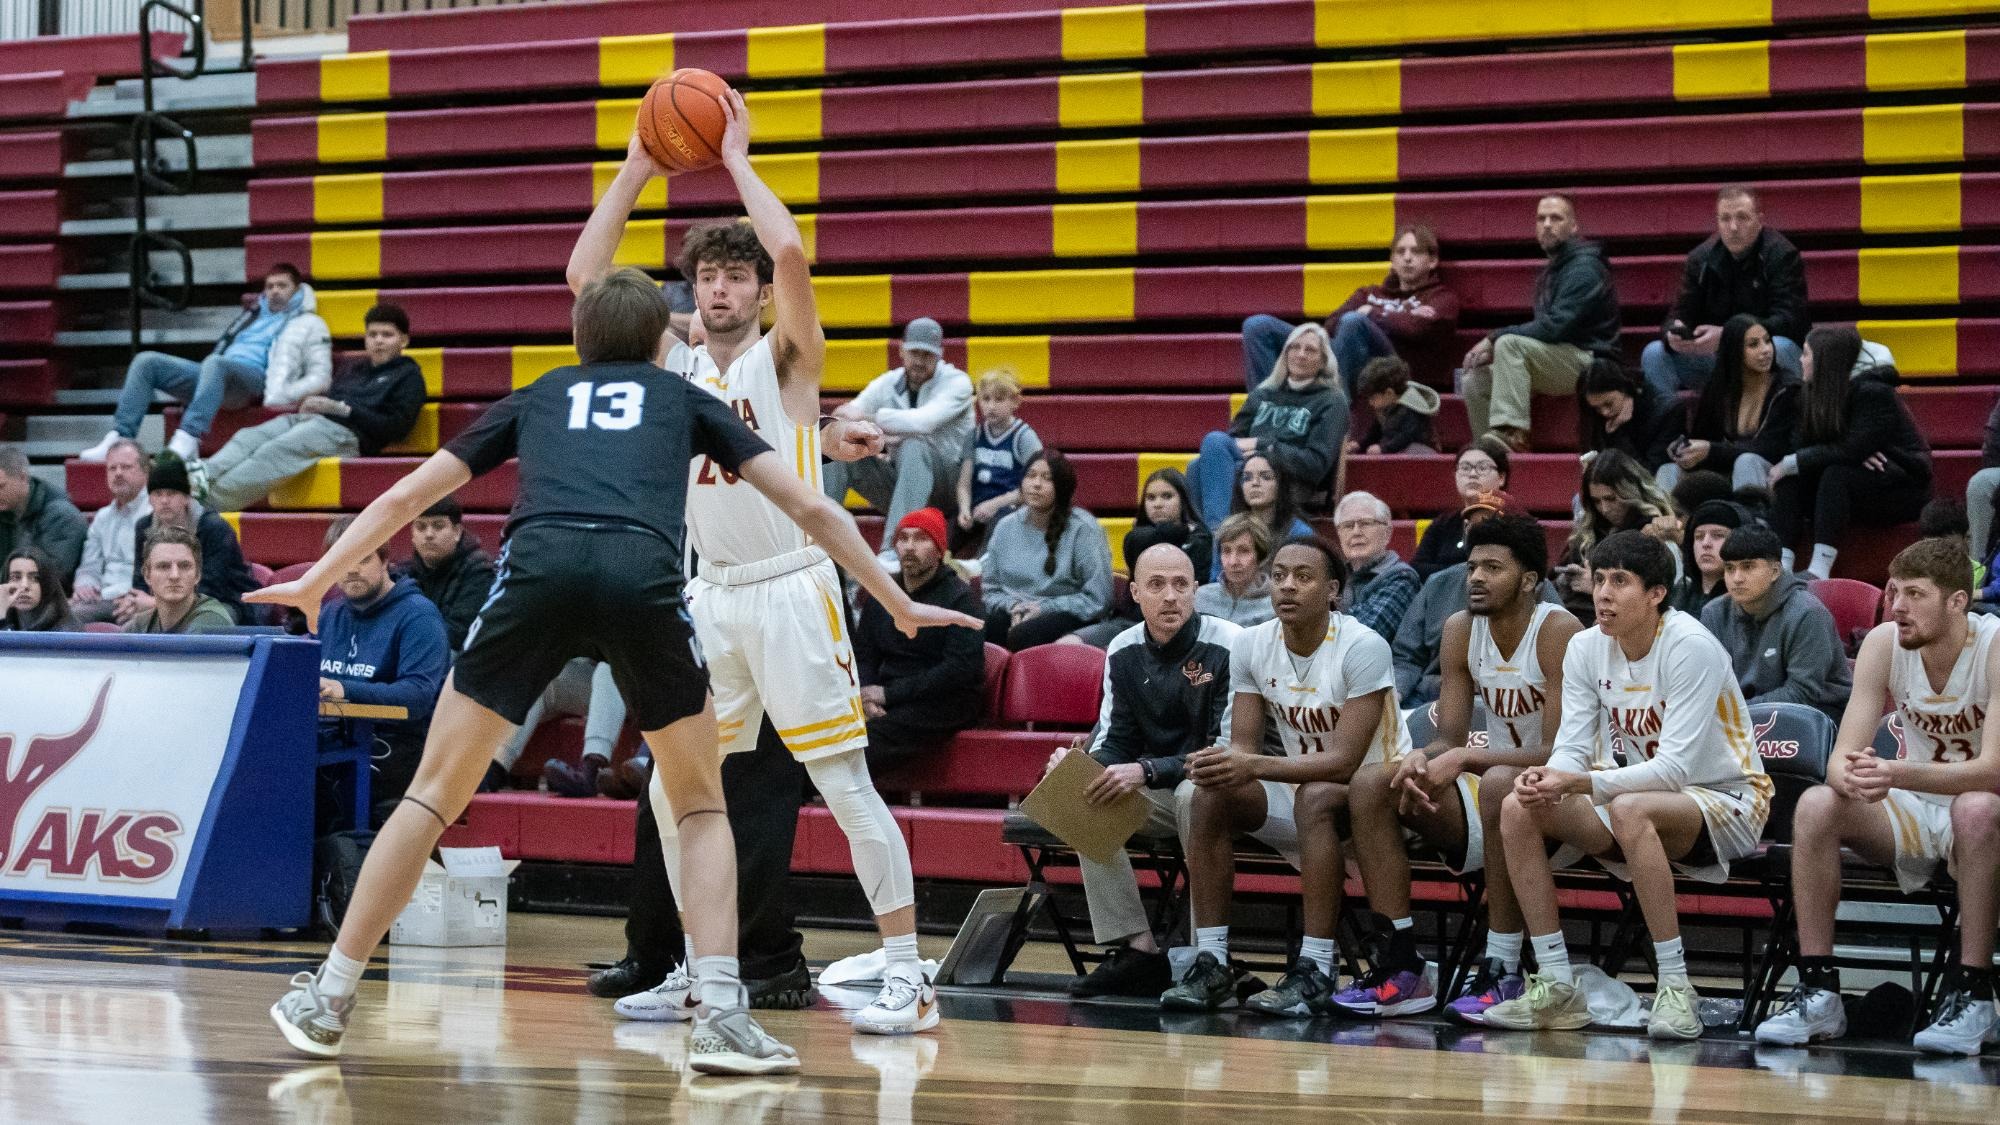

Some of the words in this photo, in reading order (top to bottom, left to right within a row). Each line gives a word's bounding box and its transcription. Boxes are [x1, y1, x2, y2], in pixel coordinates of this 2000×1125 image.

[567, 381, 646, 430] 13
[320, 659, 376, 678] ARNERS
[1505, 722, 1522, 748] 1
[1927, 734, 1975, 763] 23
